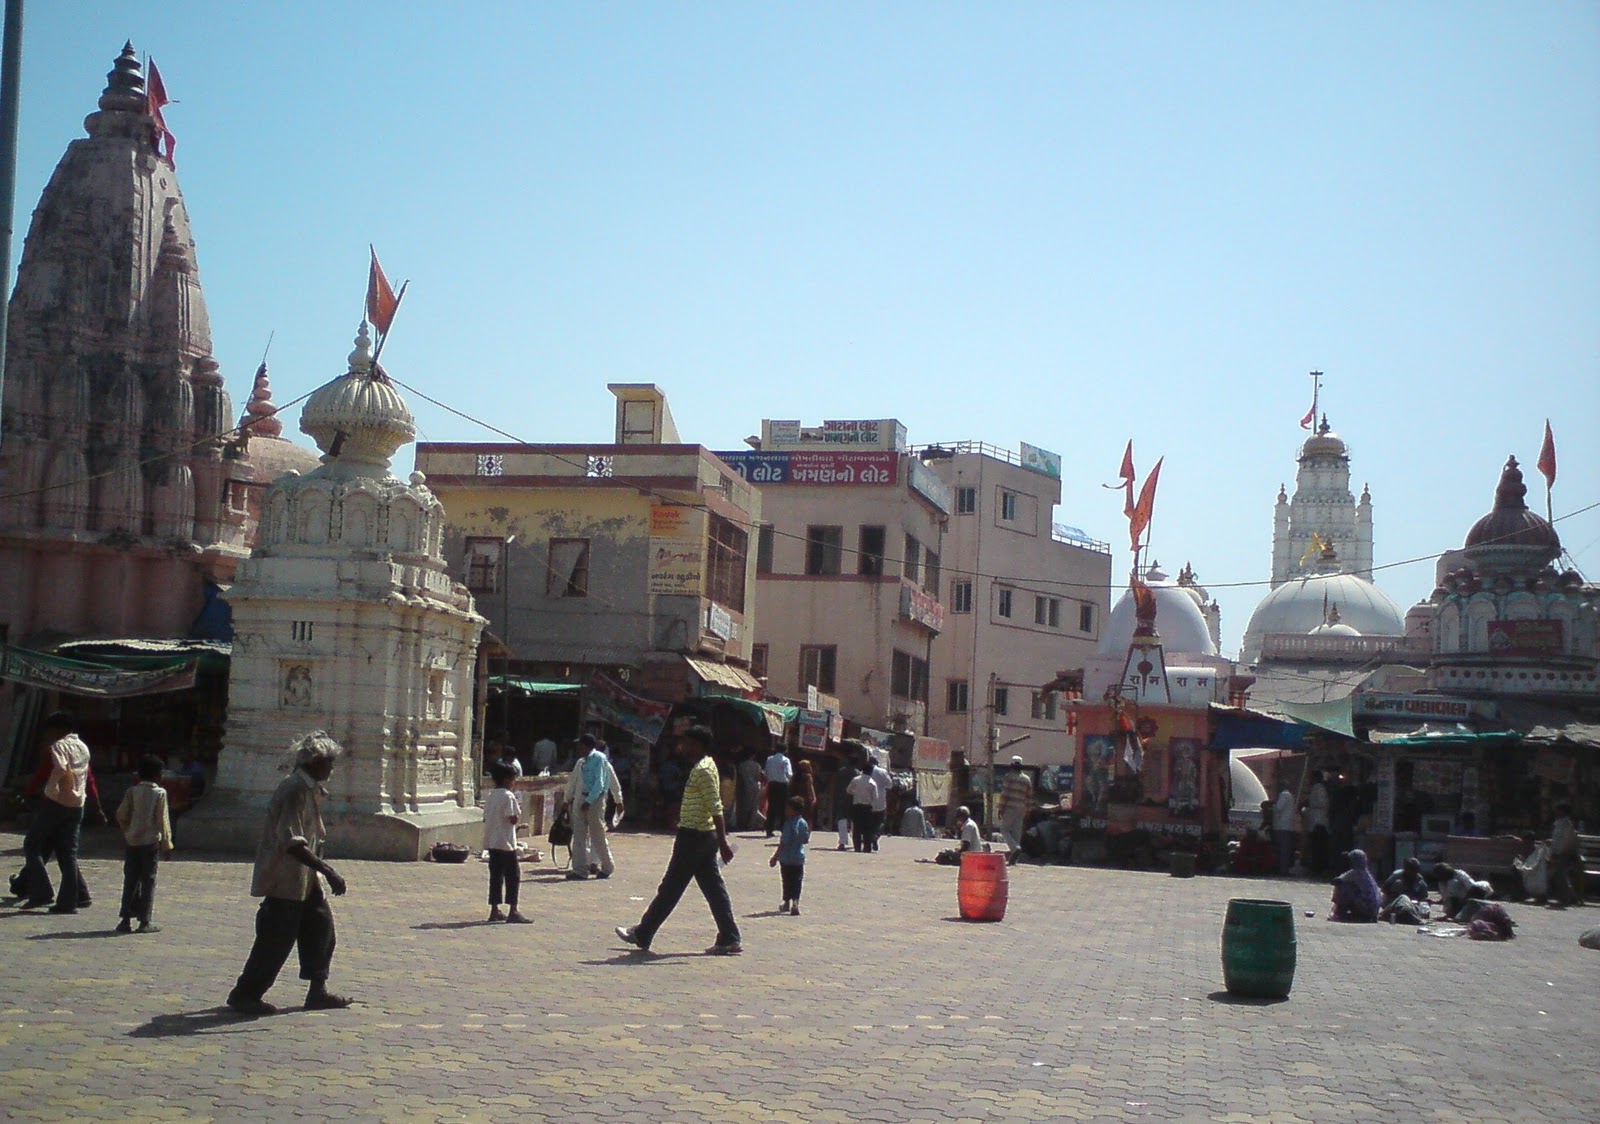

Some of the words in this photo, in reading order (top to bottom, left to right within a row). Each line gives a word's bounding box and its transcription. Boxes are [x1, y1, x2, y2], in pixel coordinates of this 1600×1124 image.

[752, 462, 782, 481] લોટ
[792, 465, 854, 482] ખમણનો
[860, 465, 889, 482] લોટ
